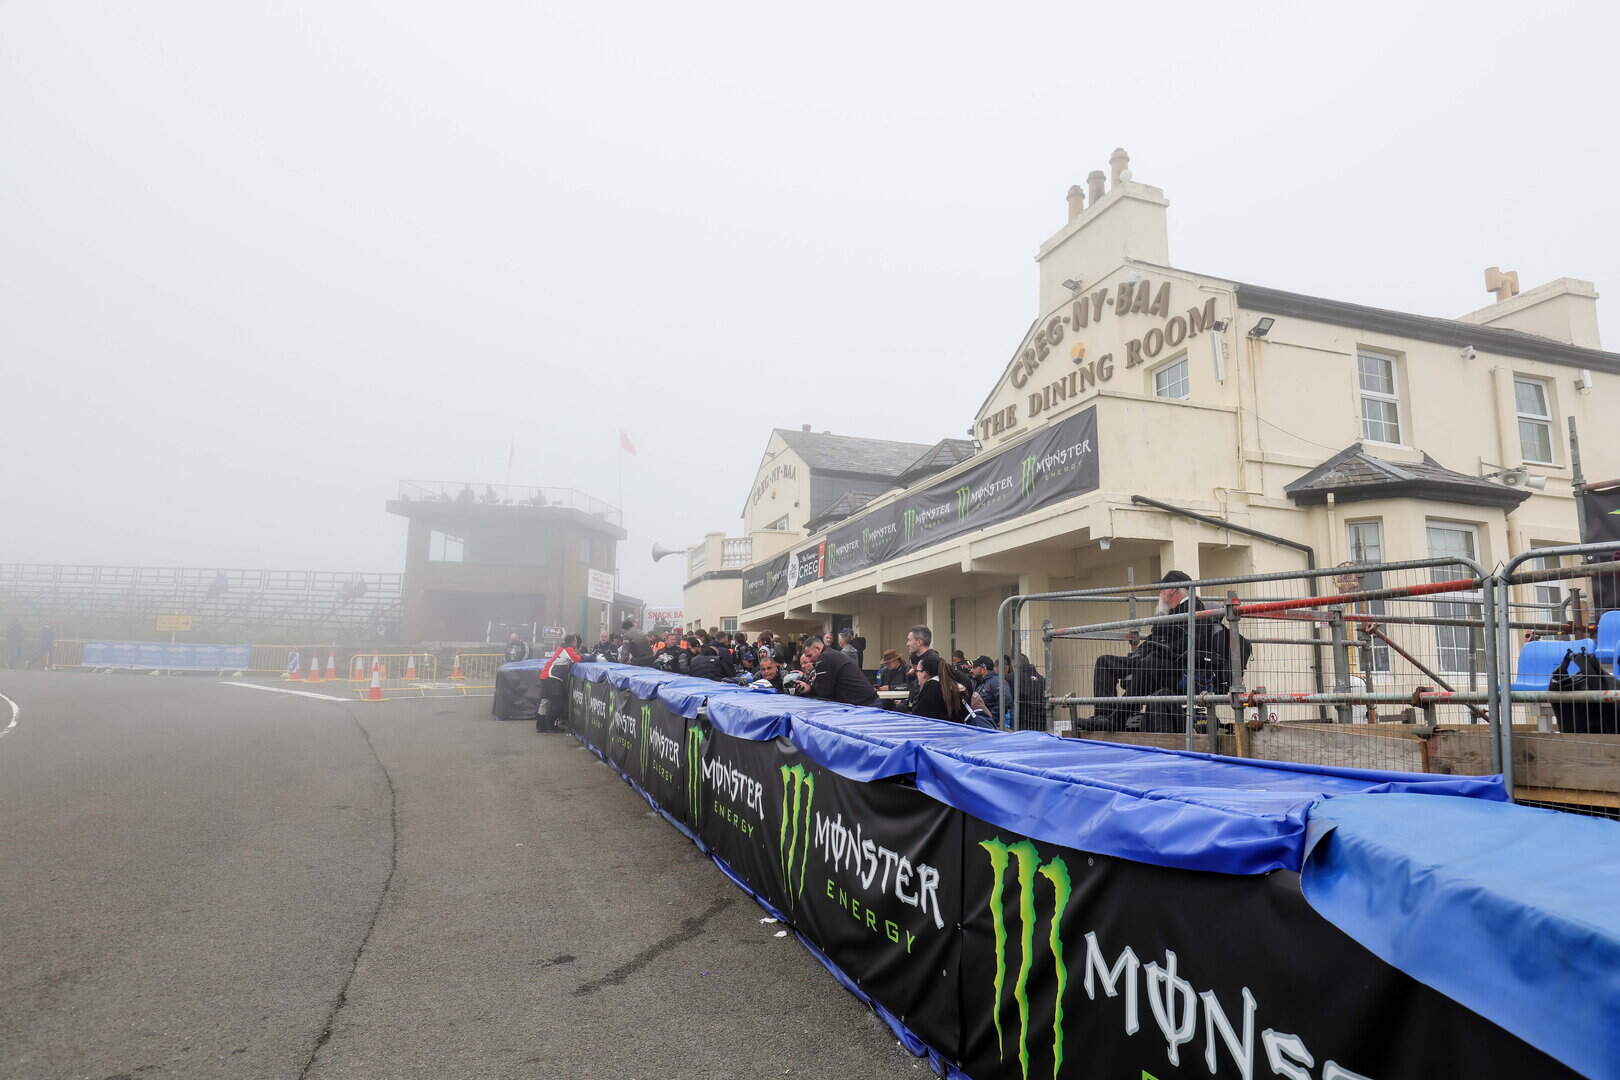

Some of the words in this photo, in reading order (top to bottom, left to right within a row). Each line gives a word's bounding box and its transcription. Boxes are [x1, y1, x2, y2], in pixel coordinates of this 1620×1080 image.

[981, 404, 1017, 441] THE
[1028, 353, 1114, 418] DINING
[1125, 296, 1217, 369] ROOM
[799, 560, 819, 578] CREG
[648, 611, 672, 620] SNACK
[649, 724, 680, 769] MONSTER
[702, 755, 765, 820] MONSTER
[714, 799, 754, 838] ENERGY
[815, 810, 945, 930] MONSTER
[826, 879, 916, 954] ENERGY
